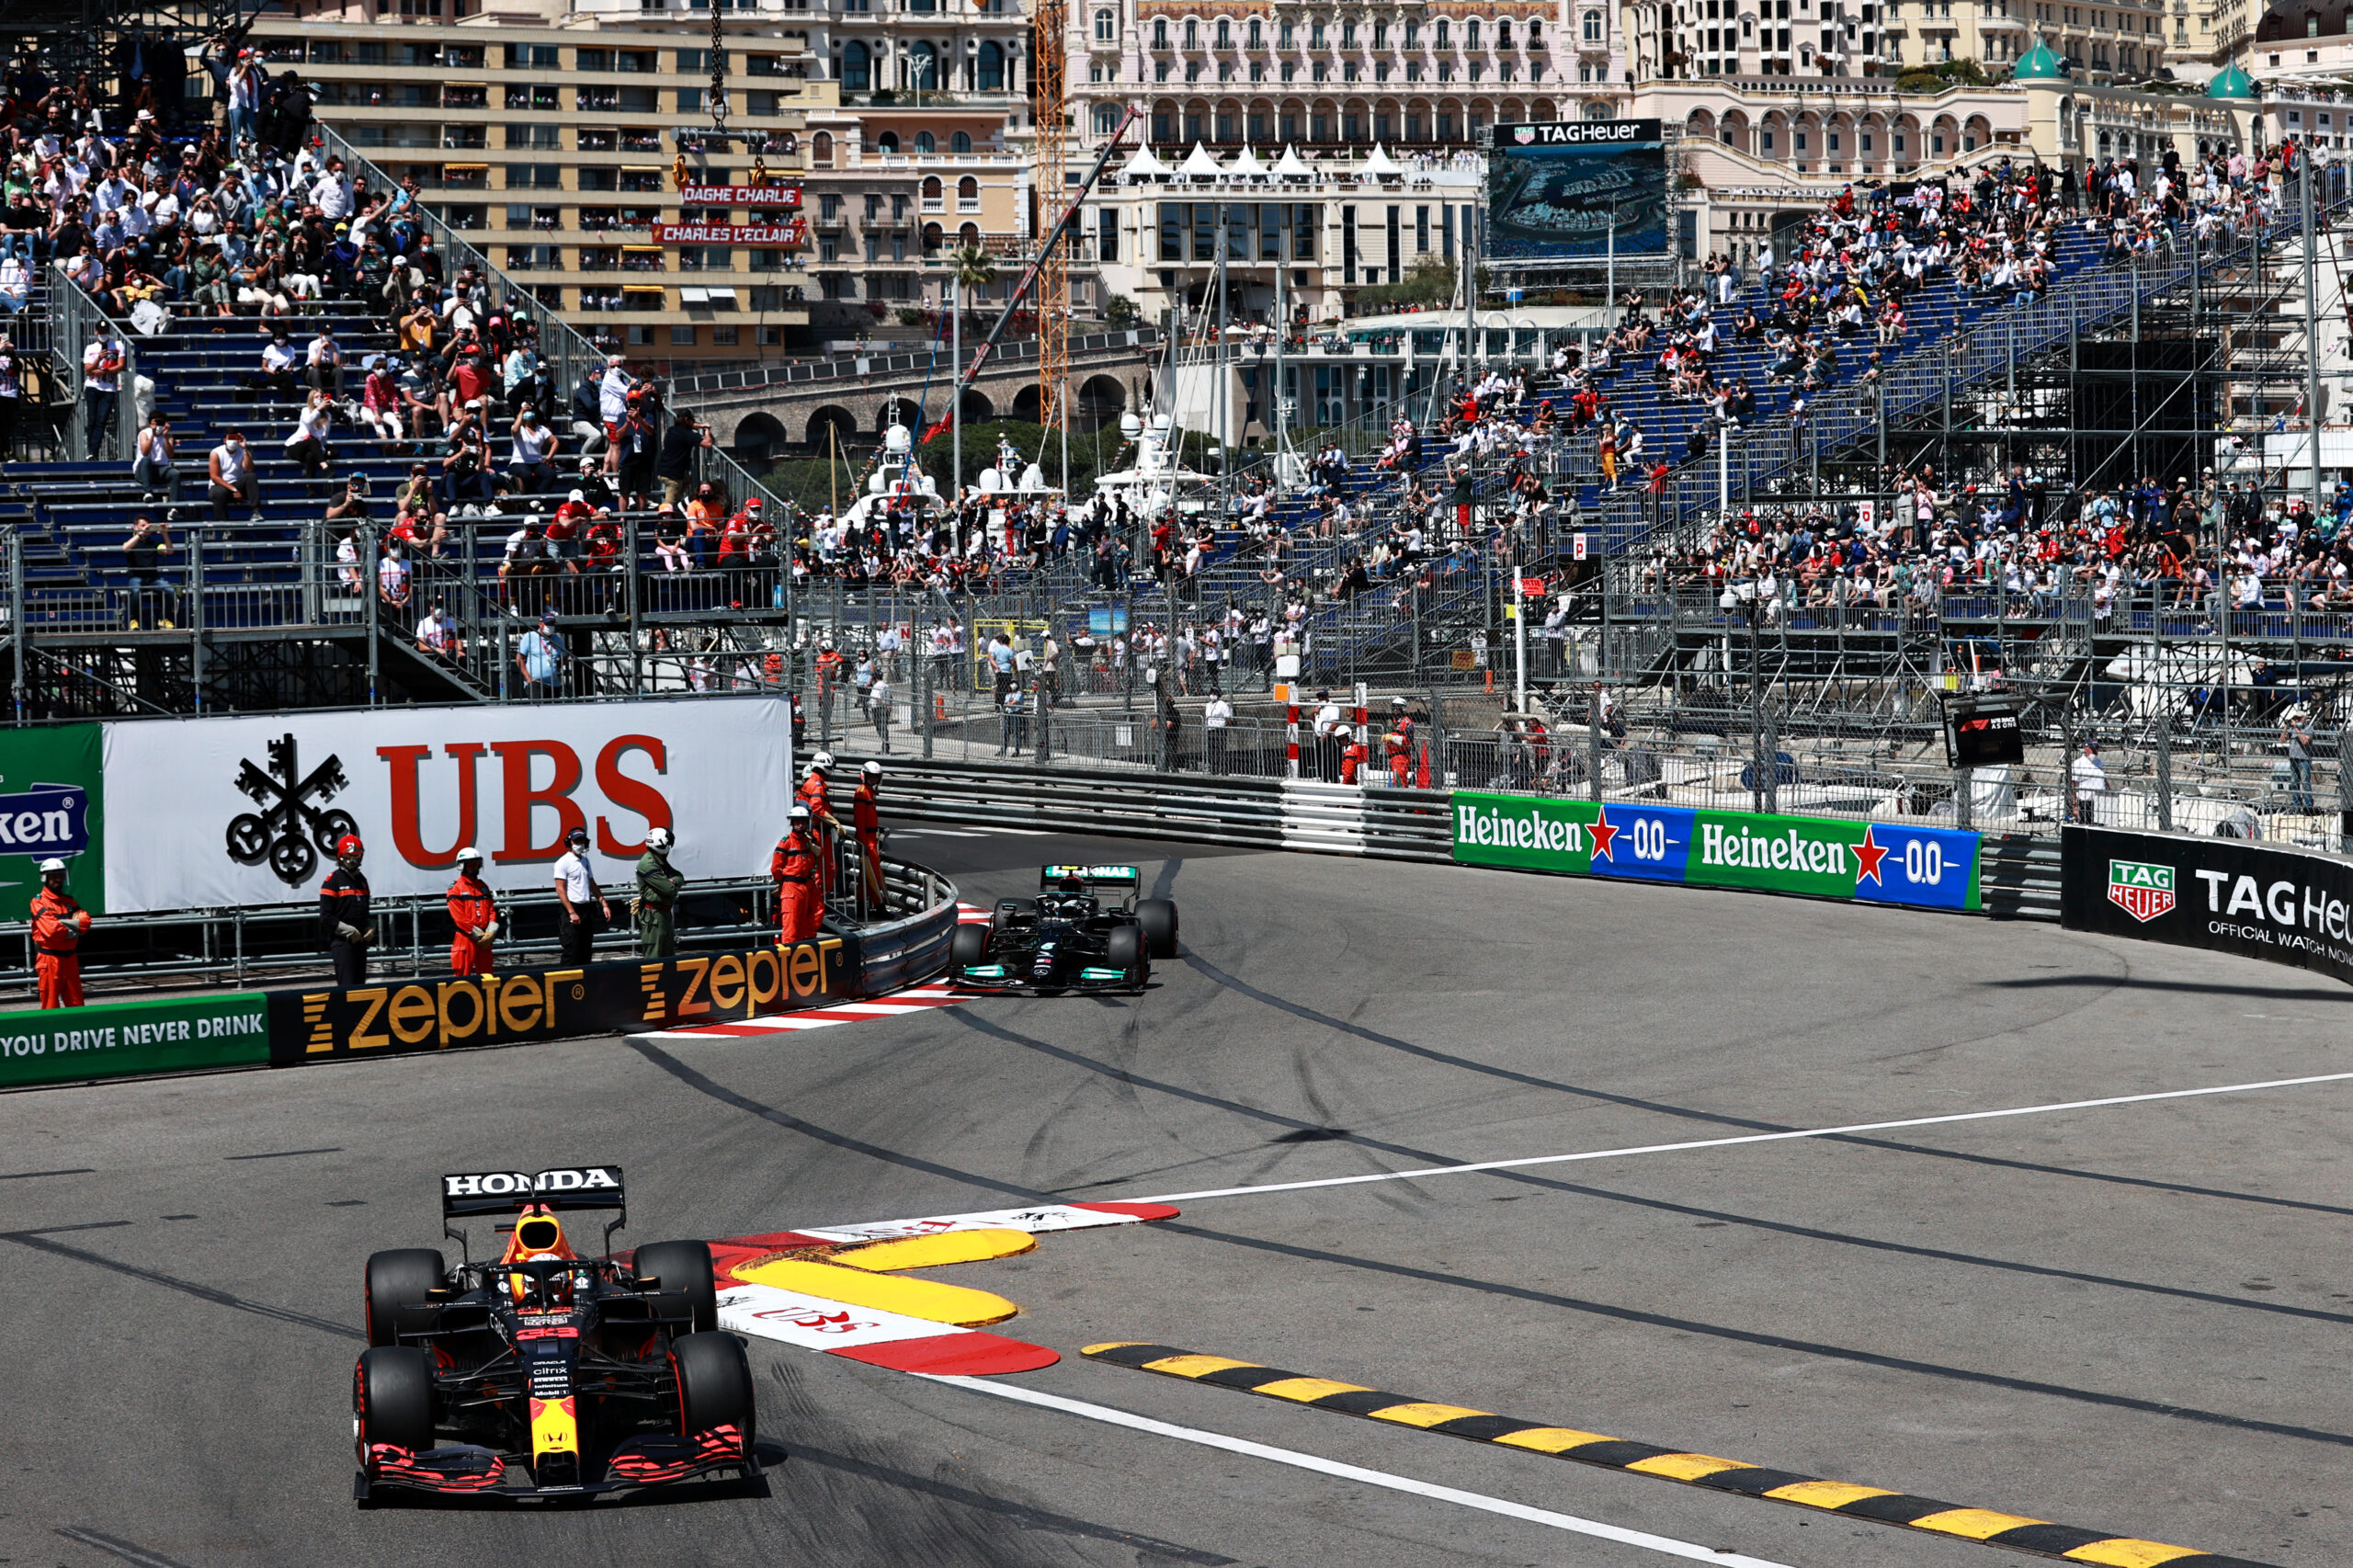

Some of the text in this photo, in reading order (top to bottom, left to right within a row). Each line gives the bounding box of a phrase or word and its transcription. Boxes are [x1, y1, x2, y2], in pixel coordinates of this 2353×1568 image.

[685, 187, 796, 203] DAGHE CHARLIE
[664, 227, 795, 243] CHARLES L'ECLAIR
[901, 628, 911, 640] N
[376, 734, 675, 869] UBS
[1458, 805, 1583, 852] Heineken
[1701, 824, 1847, 874] Heineken
[2115, 863, 2169, 889] TAG
[2110, 886, 2172, 918] HEUER
[2208, 920, 2274, 944] OFFICIAL
[2278, 932, 2325, 956] WATCH
[676, 937, 843, 1018] zepter
[346, 969, 584, 1050] zepter
[0, 1013, 265, 1057] YOU DRIVE NEVER DRINK
[445, 1168, 620, 1196] HONDA
[752, 1306, 881, 1334] UBS
[533, 1367, 567, 1375] citrix
